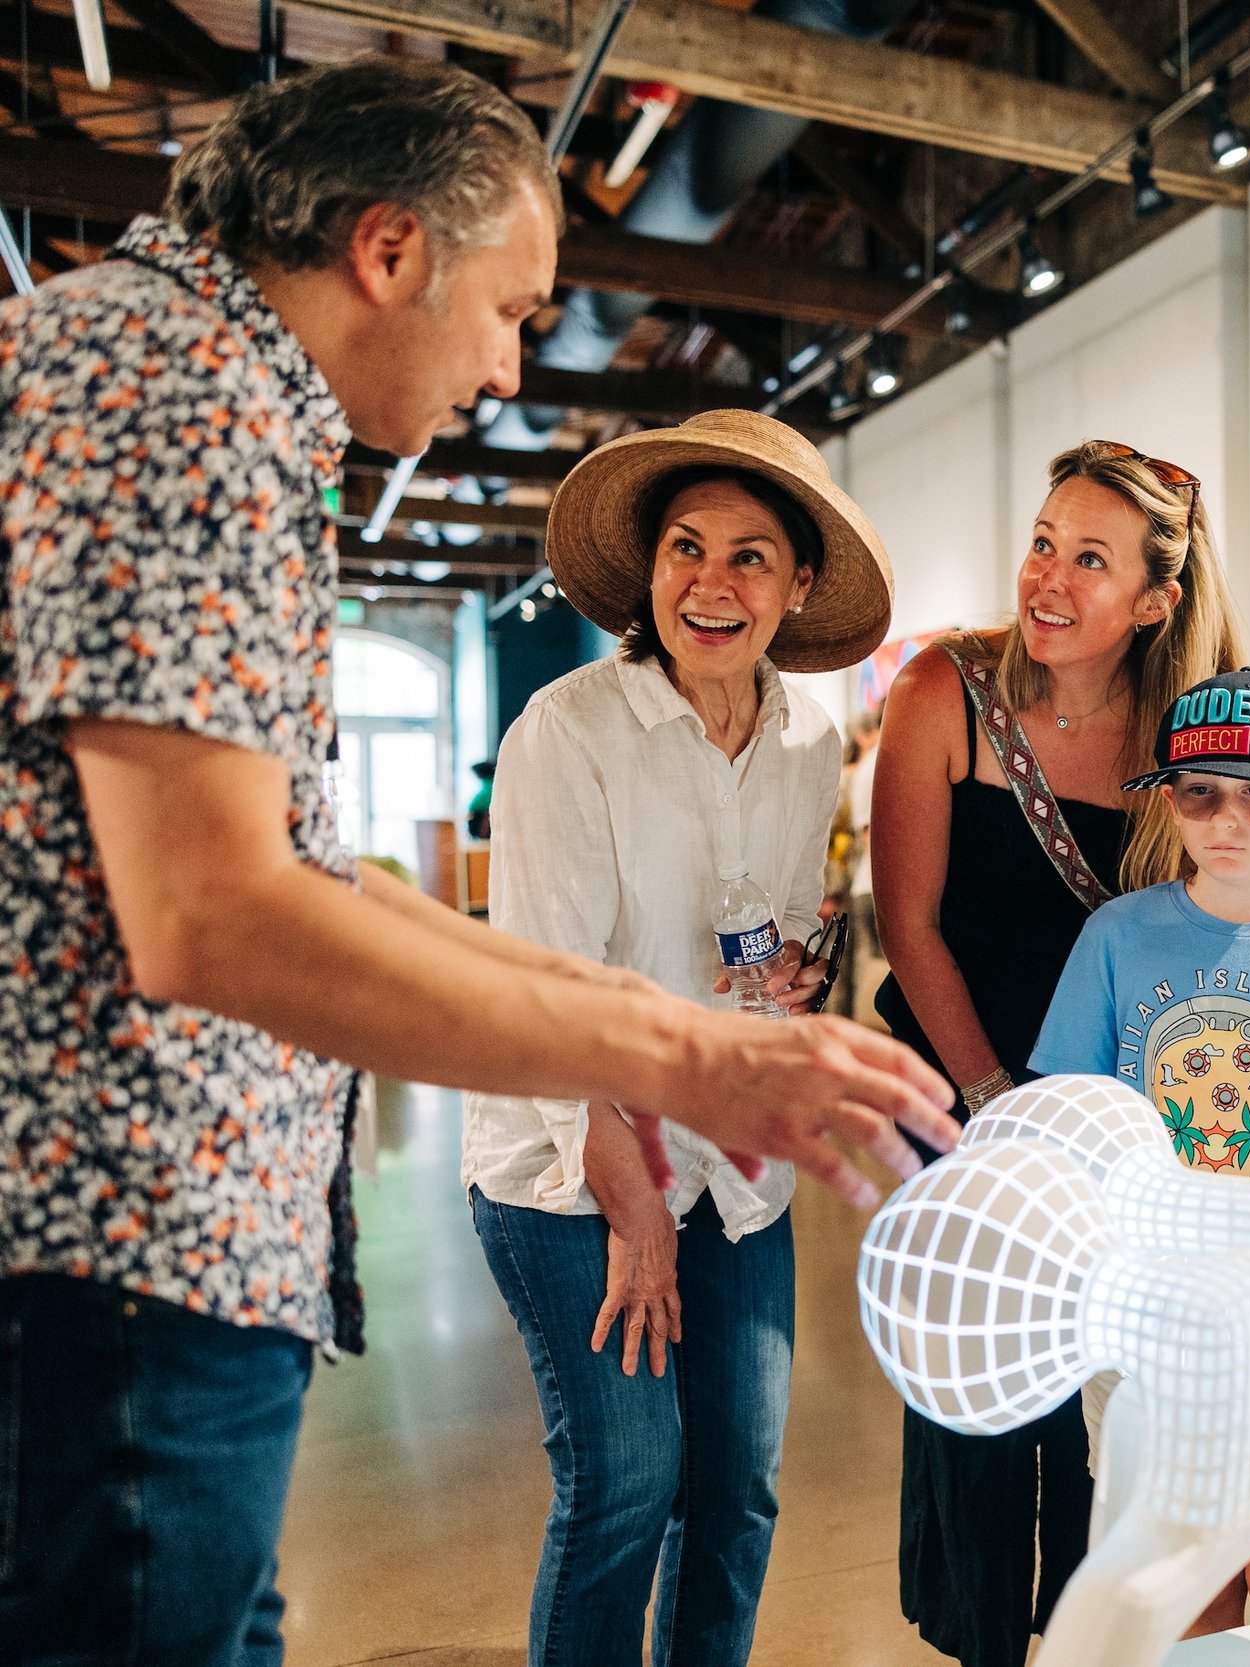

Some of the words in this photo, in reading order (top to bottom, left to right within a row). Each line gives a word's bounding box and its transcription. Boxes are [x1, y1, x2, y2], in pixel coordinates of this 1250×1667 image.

[1172, 729, 1244, 757] PERFECT
[739, 929, 770, 947] DEER
[741, 939, 774, 957] PARK
[1119, 978, 1176, 1081] AIIAN
